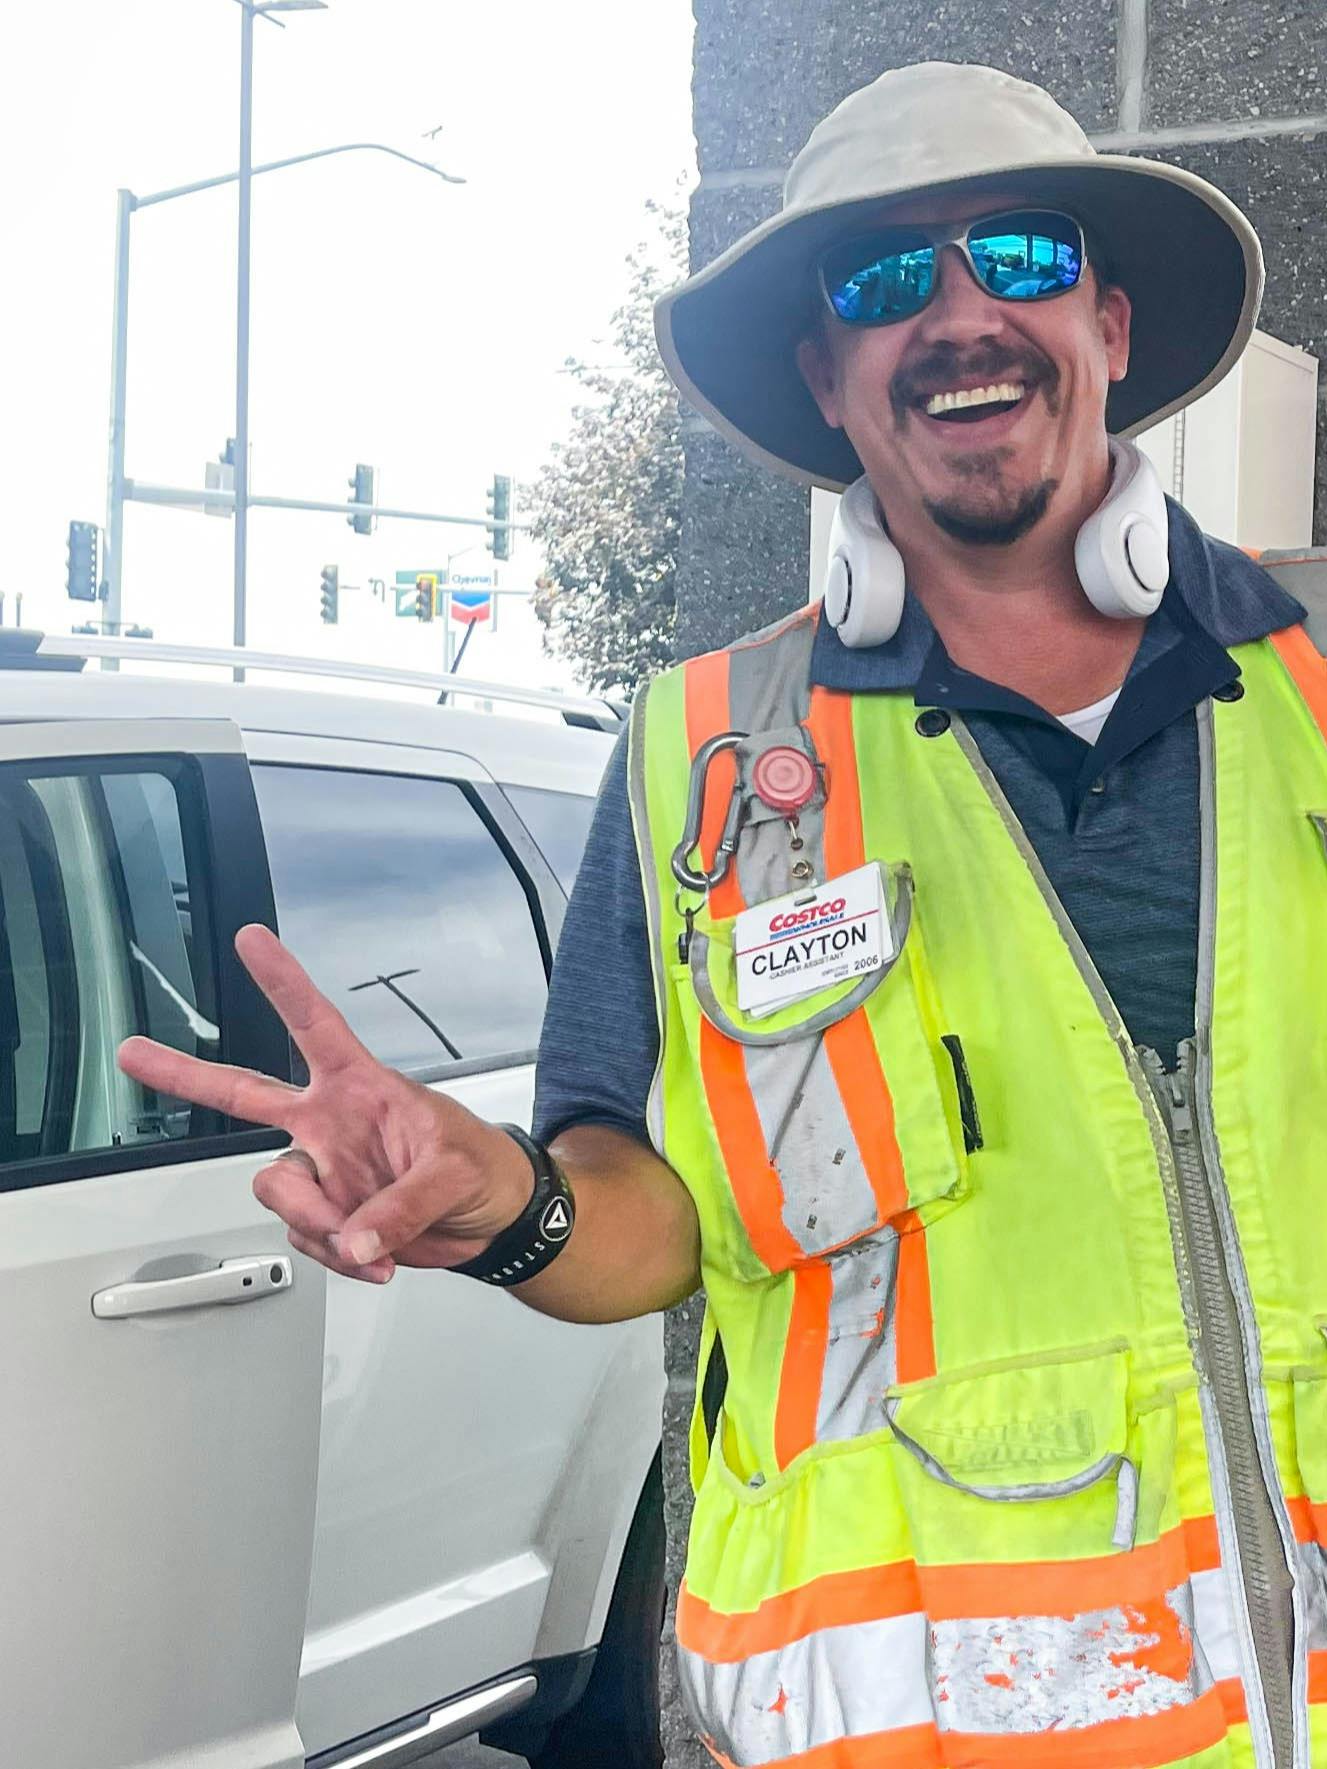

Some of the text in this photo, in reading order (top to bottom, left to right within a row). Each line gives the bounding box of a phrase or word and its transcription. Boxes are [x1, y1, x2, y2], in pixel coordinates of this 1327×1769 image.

[769, 897, 846, 932] COSTCO
[752, 922, 866, 976] CLAYTON
[854, 954, 879, 971] 2006
